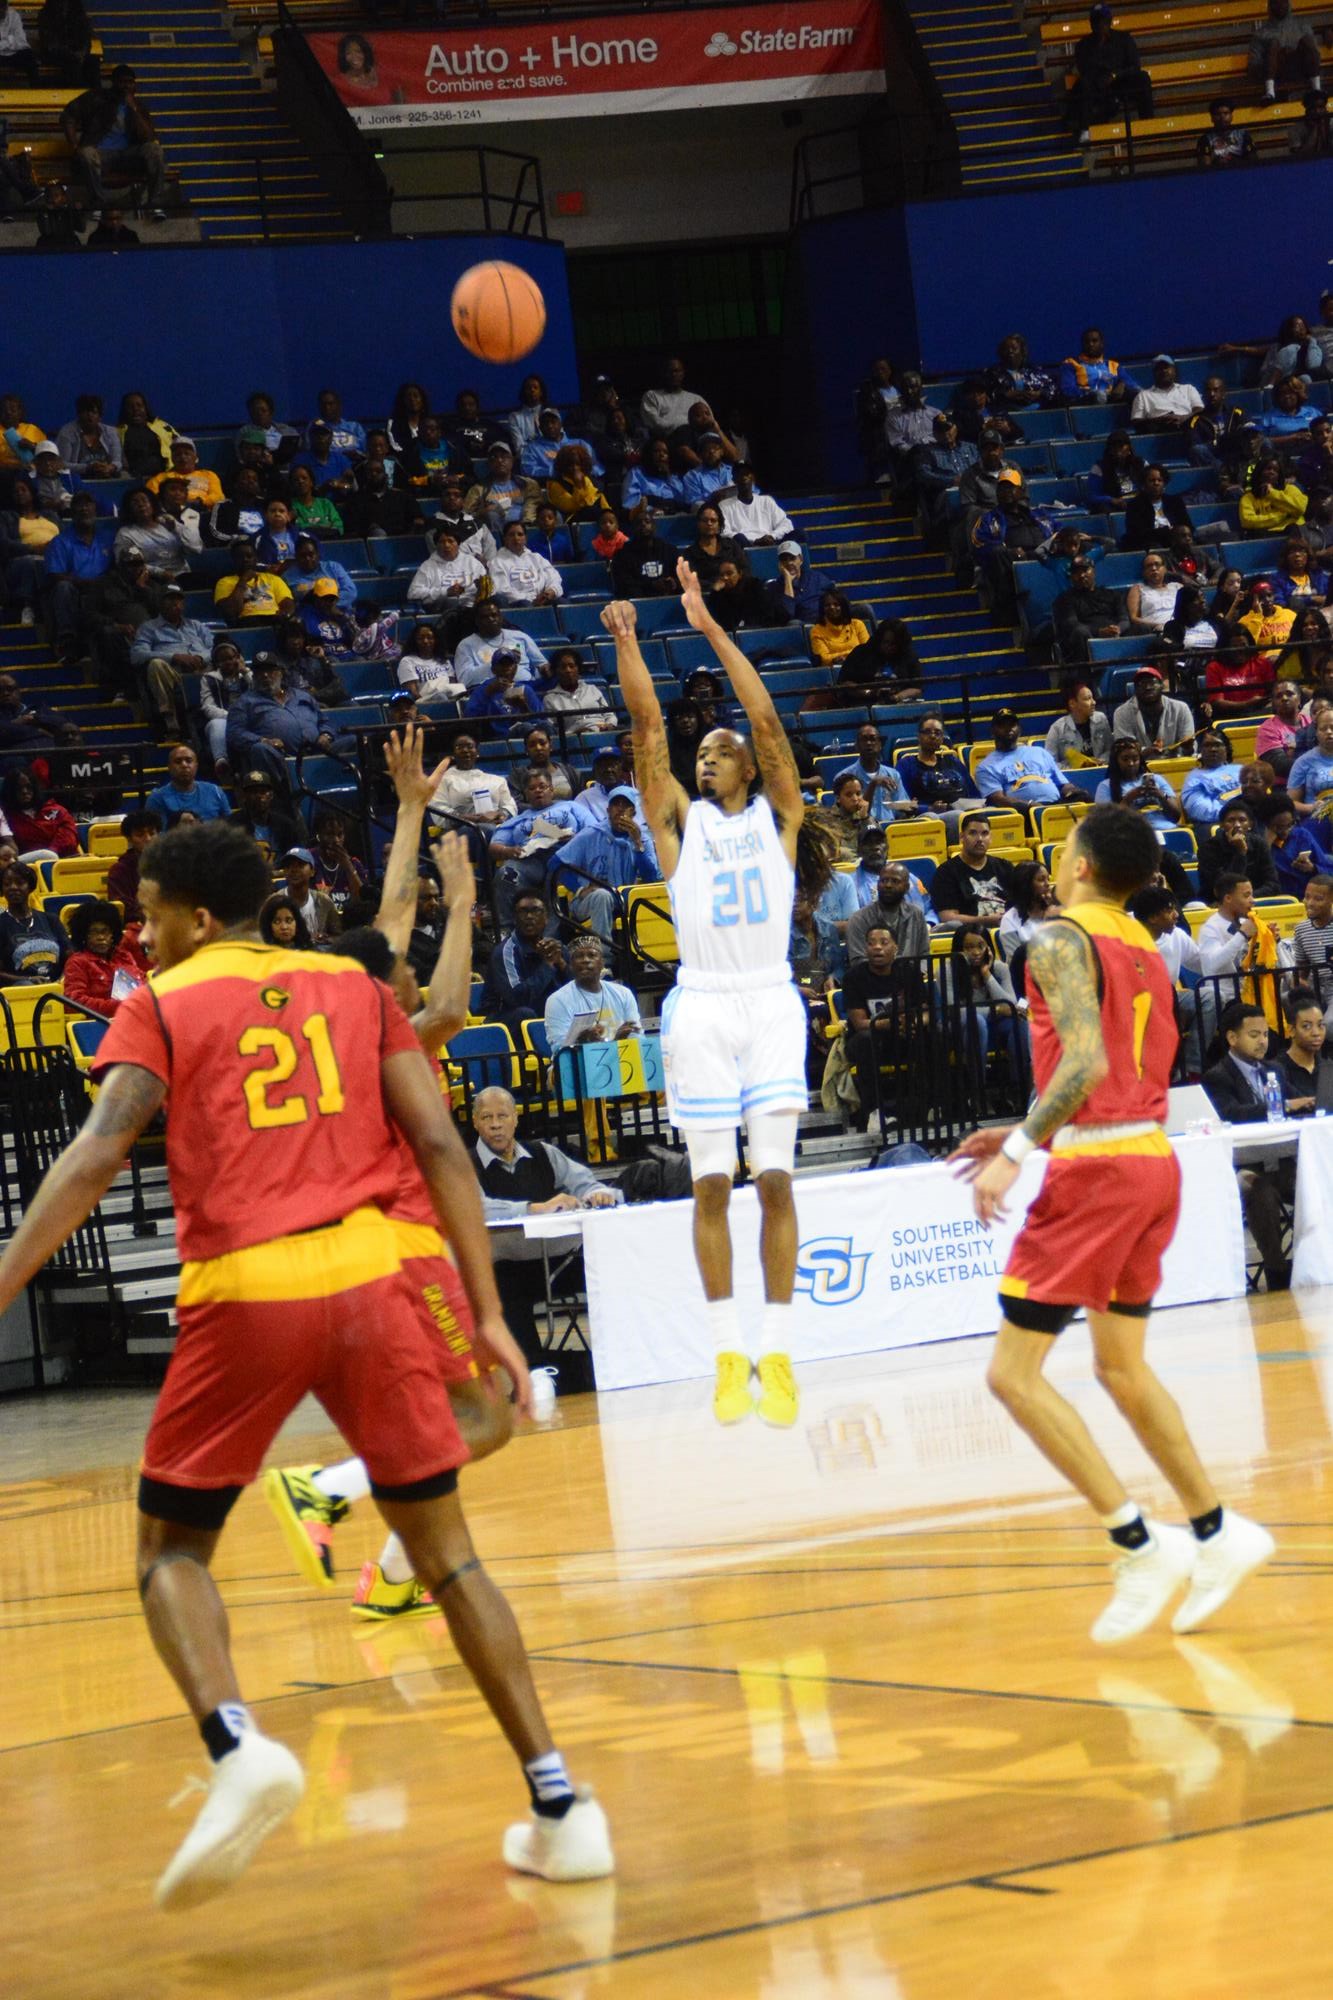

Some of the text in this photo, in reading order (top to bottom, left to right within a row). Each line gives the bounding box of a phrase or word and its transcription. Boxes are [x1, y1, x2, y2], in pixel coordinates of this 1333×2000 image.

[424, 34, 659, 77] Auto + Home
[425, 73, 568, 95] Combine and save.
[368, 114, 403, 126] Jones
[71, 762, 113, 778] M-1
[712, 865, 770, 927] 20
[1131, 989, 1154, 1084] 1
[238, 1013, 345, 1130] 21
[891, 1218, 991, 1247] SOUTHERN
[890, 1238, 995, 1269] UNIVERSITY
[889, 1260, 1004, 1292] BASKETBALL
